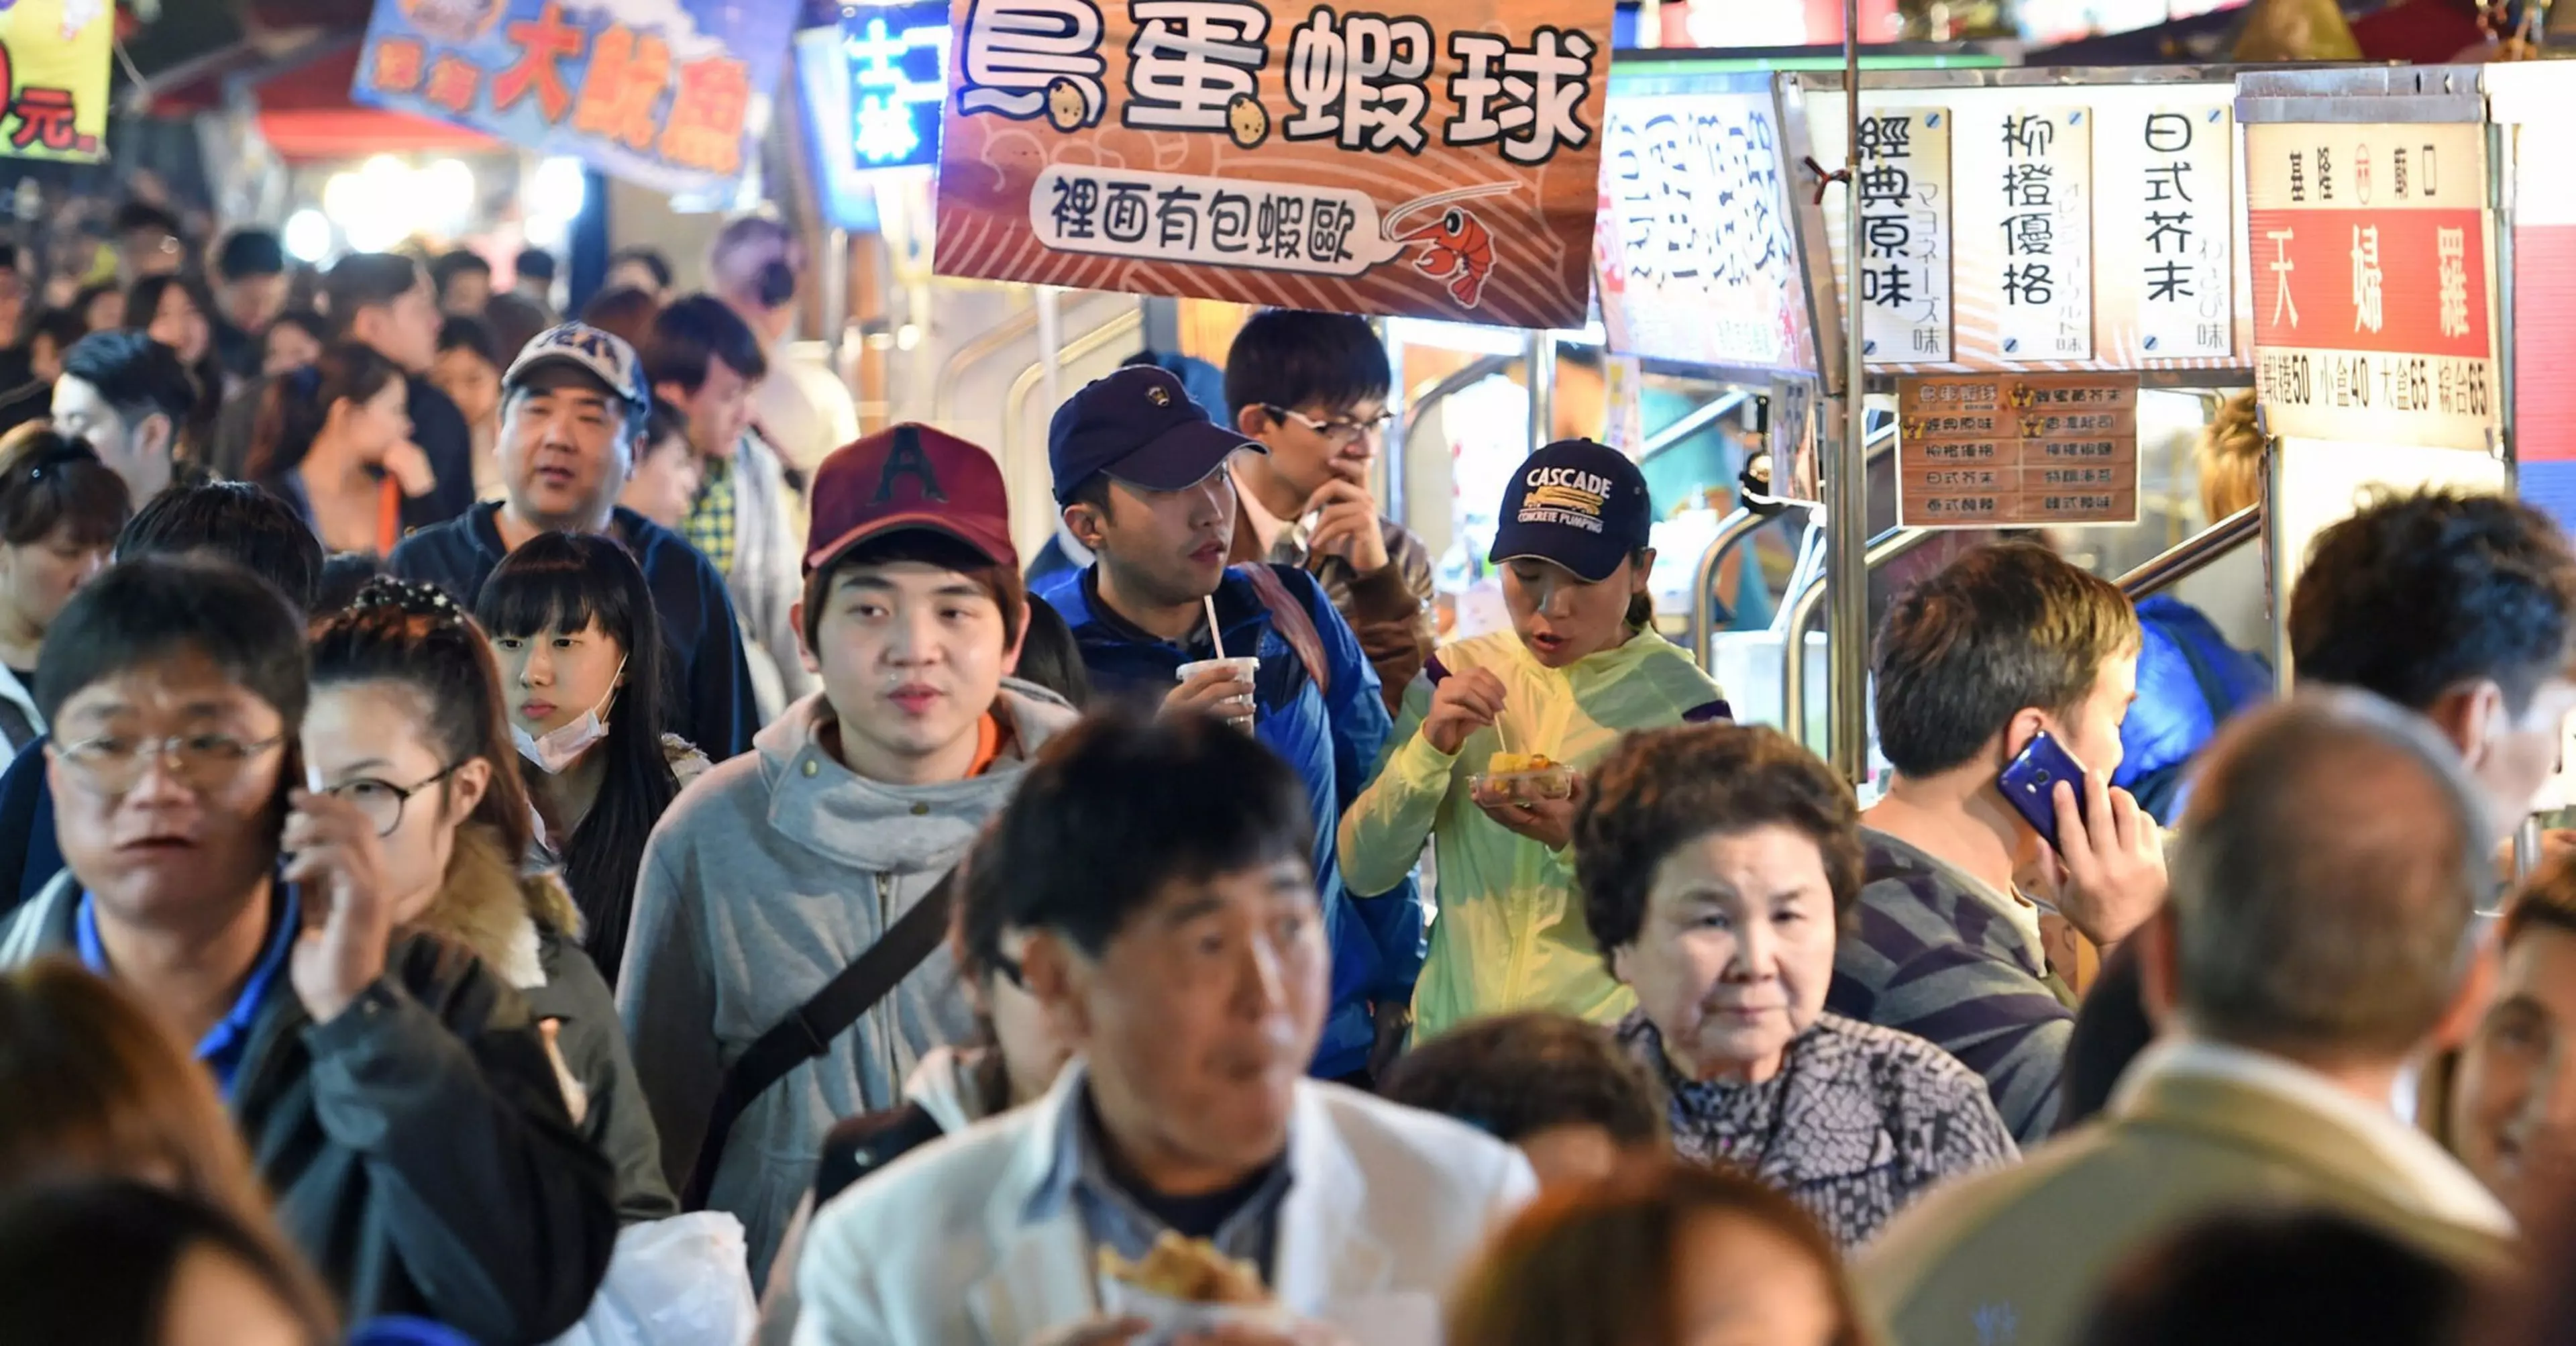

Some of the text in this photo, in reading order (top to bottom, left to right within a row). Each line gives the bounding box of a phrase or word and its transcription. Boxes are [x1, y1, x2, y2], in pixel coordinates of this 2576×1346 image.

[958, 0, 1596, 164] 鳥蛋蝦球
[1051, 176, 1356, 263] 裡面有包蝦歐
[1859, 116, 1911, 308] 經典原味
[1913, 182, 1941, 354] マヨネーズ味
[2000, 115, 2054, 305] 柳橙優格
[2143, 113, 2194, 303] 日式芥末
[2266, 223, 2470, 339] 天婦羅
[2320, 355, 2370, 408] 小盒40
[2380, 356, 2429, 411] 大盒65
[1518, 512, 1604, 534] CONCRETE PUMPING
[1526, 466, 1613, 499] CASCADE
